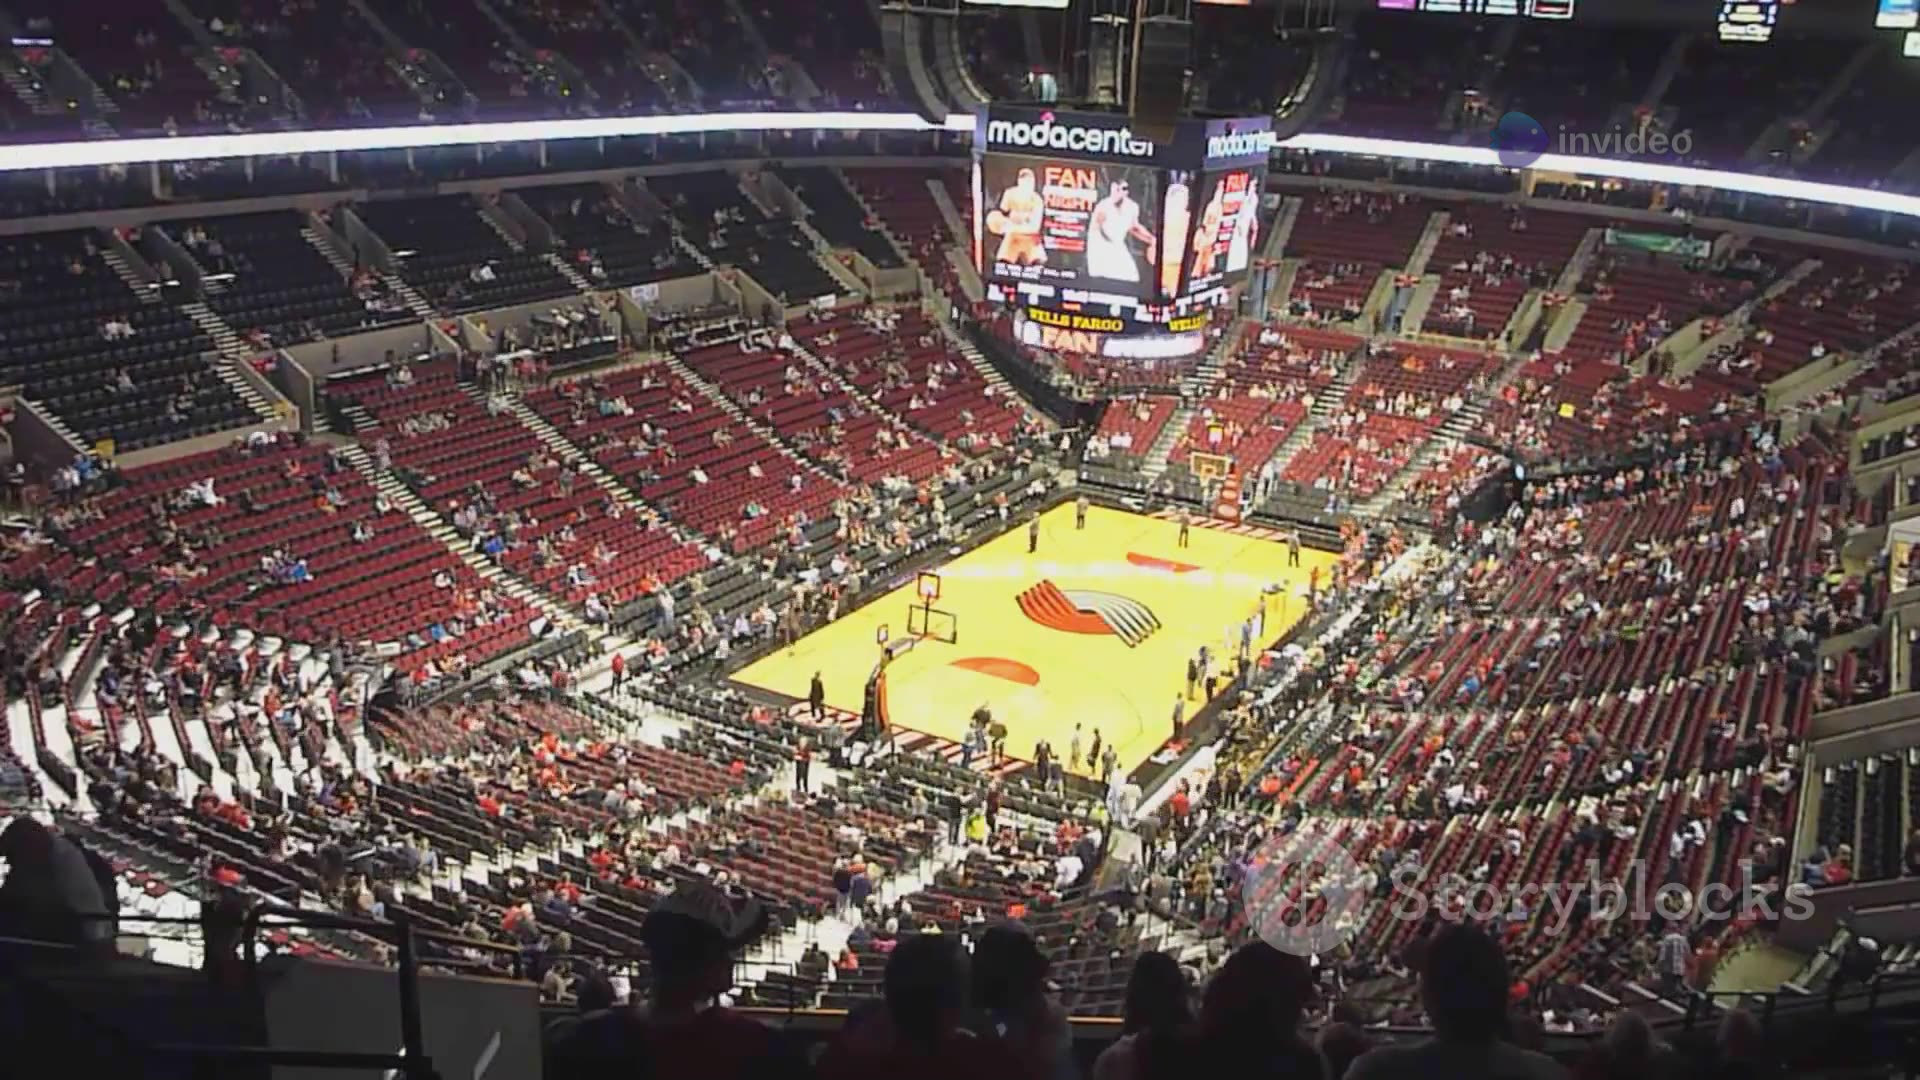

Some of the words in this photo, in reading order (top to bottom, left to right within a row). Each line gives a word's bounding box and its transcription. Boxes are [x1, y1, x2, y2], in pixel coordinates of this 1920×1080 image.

[1045, 167, 1096, 190] FAN
[1028, 308, 1069, 327] WELLS
[1072, 315, 1124, 332] FARGO
